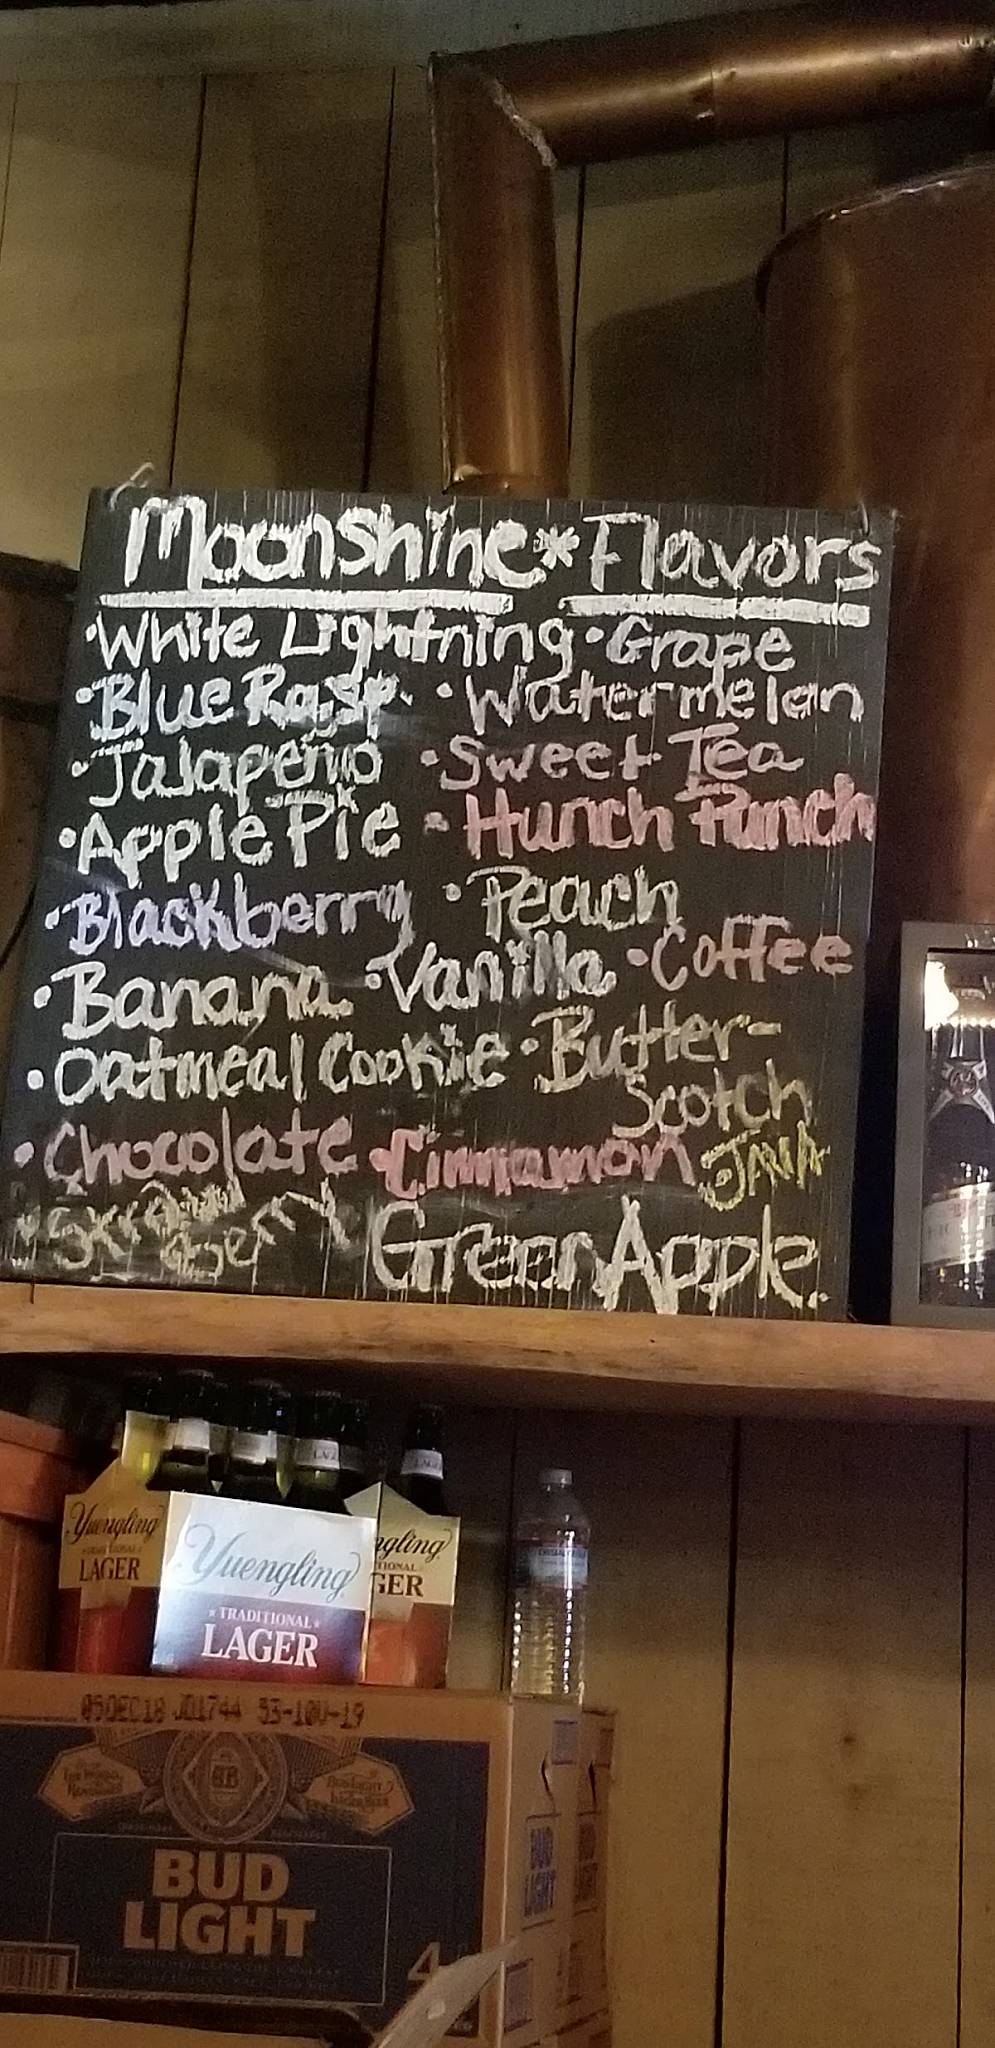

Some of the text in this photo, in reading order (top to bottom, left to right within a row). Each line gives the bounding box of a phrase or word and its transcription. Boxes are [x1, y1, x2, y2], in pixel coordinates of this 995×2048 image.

[124, 496, 881, 592] Moonshine Flavors
[97, 607, 796, 682] White Lightning Grape
[90, 668, 234, 740] Blue
[465, 667, 864, 735] Watermelon
[440, 734, 662, 790] Sweet
[668, 723, 803, 785] Tea
[77, 773, 876, 888] Apple Pie Hunch Punch
[63, 865, 684, 957] Blackberry Peach
[51, 914, 853, 1040] Banana Vanilla Coffee
[54, 1032, 306, 1105] Oatmeal
[318, 1023, 509, 1094] Cookie
[44, 1106, 358, 1185] Chocolate
[386, 1125, 695, 1199] Cinnamon
[373, 1202, 605, 1293] Green
[65, 1501, 166, 1545] Yuengling
[374, 1528, 453, 1564] ngling
[80, 1557, 141, 1581] LAGER
[178, 1523, 361, 1603] Yuengling
[371, 1572, 424, 1598] GER
[201, 1623, 318, 1668] LAGER
[219, 1606, 313, 1629] TRADITIONAL
[152, 1848, 291, 1901] BUD
[123, 1901, 317, 1957] LIGHT
